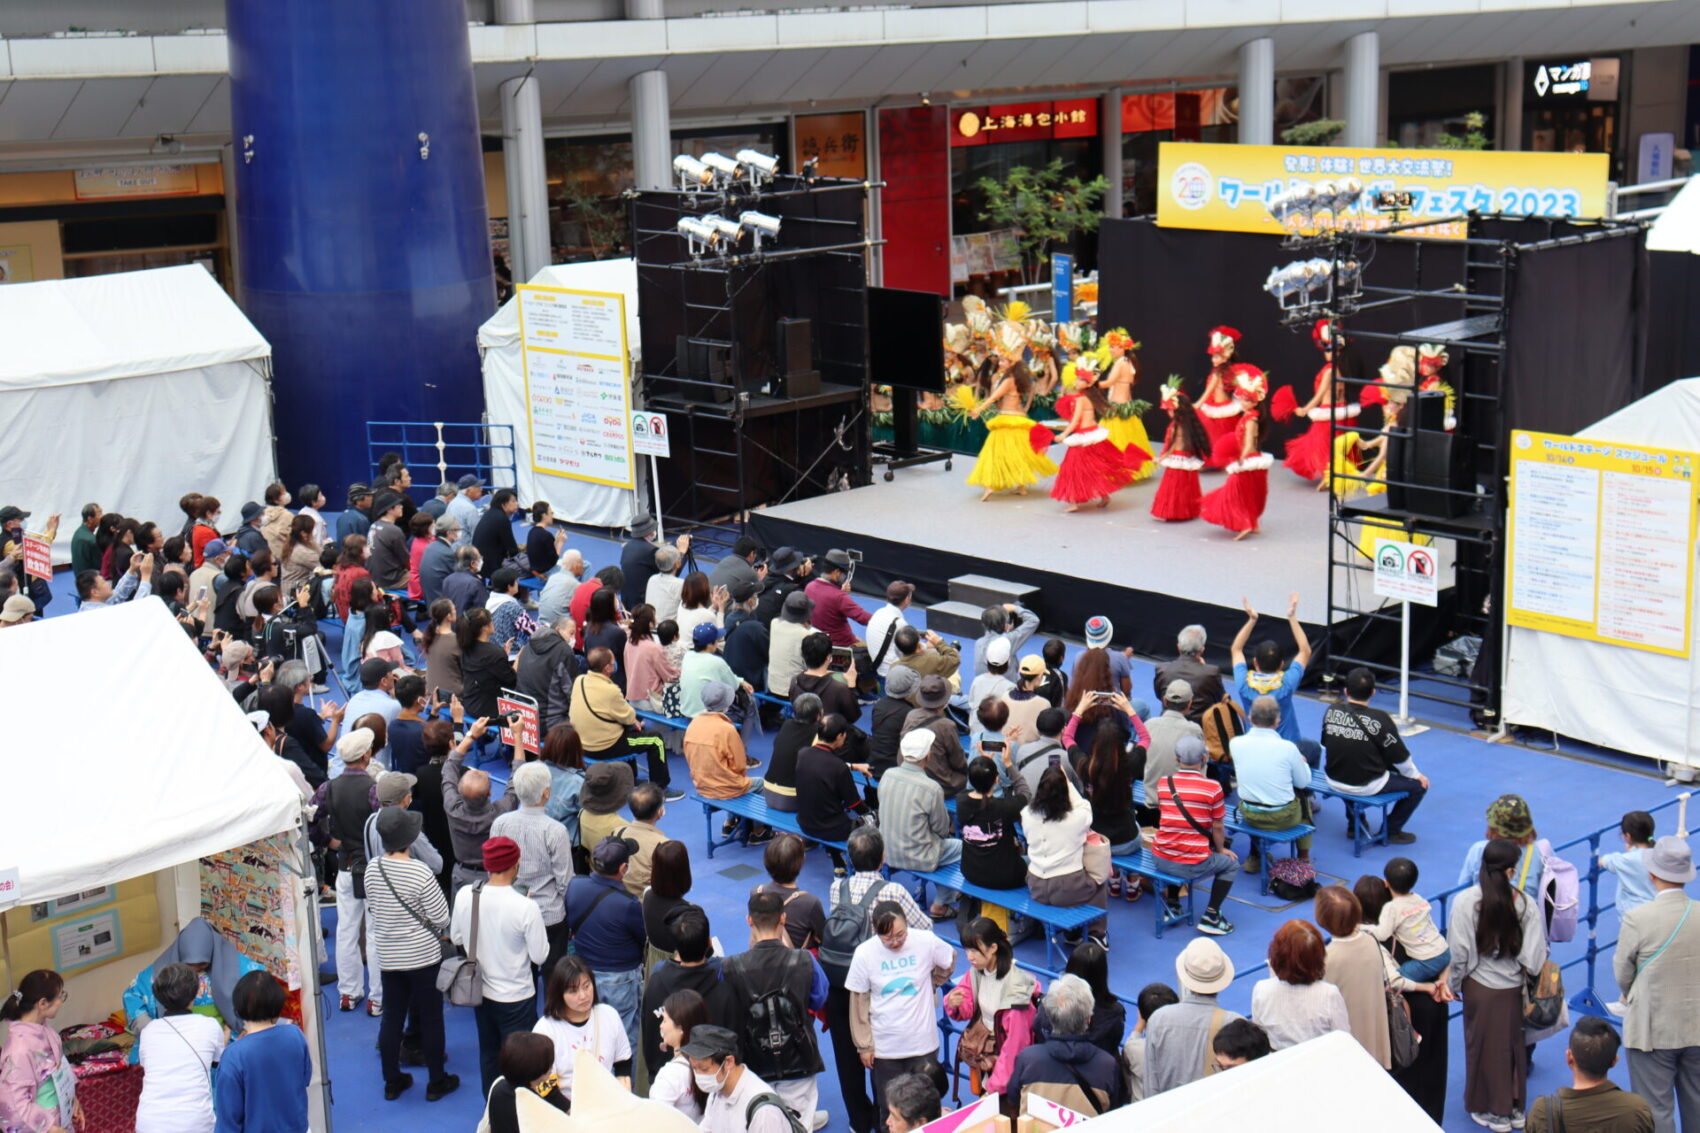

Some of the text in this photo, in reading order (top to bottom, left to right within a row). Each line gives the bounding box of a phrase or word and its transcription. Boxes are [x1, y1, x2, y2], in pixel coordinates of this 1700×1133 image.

[981, 109, 1087, 131] 上海湯包小館
[1500, 187, 1580, 217] 2023
[504, 727, 538, 748] 飲禁止
[881, 955, 917, 971] ALOE
